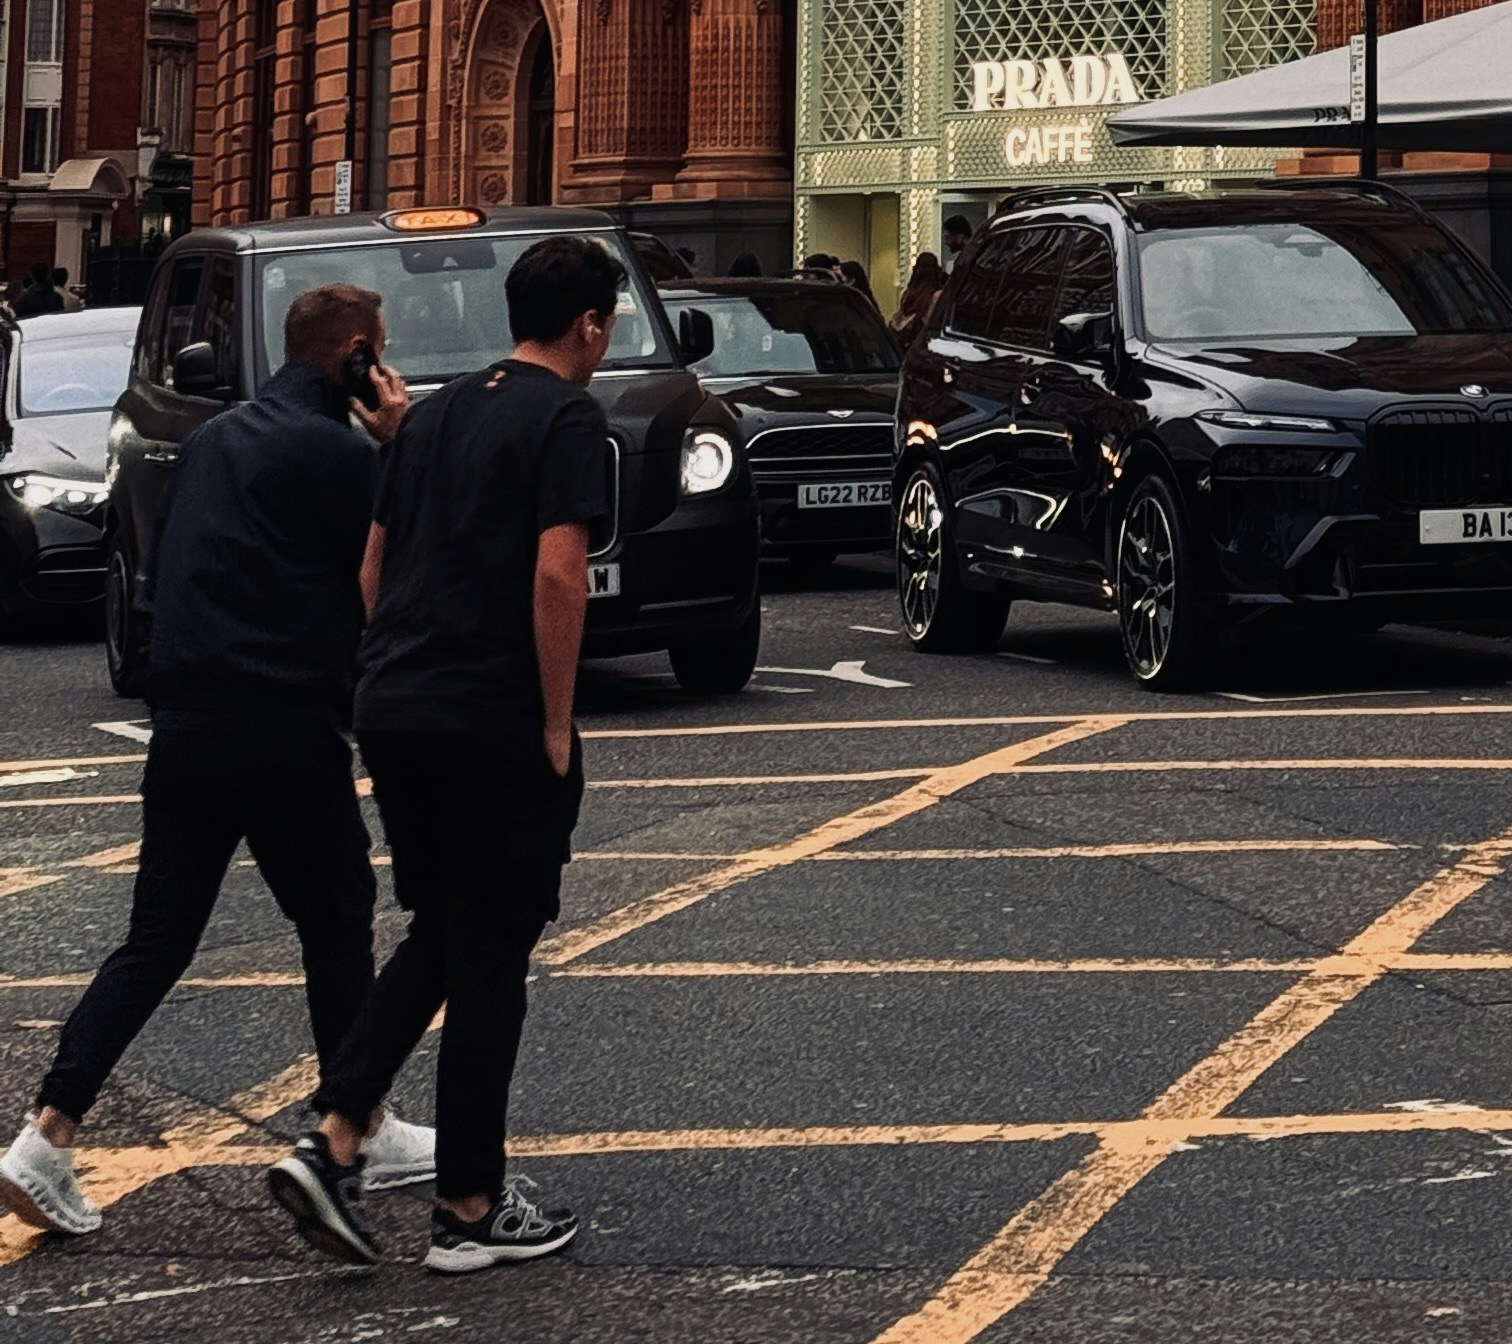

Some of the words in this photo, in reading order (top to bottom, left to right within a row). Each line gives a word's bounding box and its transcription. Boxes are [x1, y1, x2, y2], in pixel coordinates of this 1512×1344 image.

[973, 53, 1140, 111] PRADA
[1313, 106, 1352, 122] PRA
[1005, 118, 1093, 166] CAFFÈ
[405, 213, 471, 225] TAXI
[805, 486, 853, 505] LG22
[857, 484, 892, 503] RZB
[1462, 512, 1493, 538] BA
